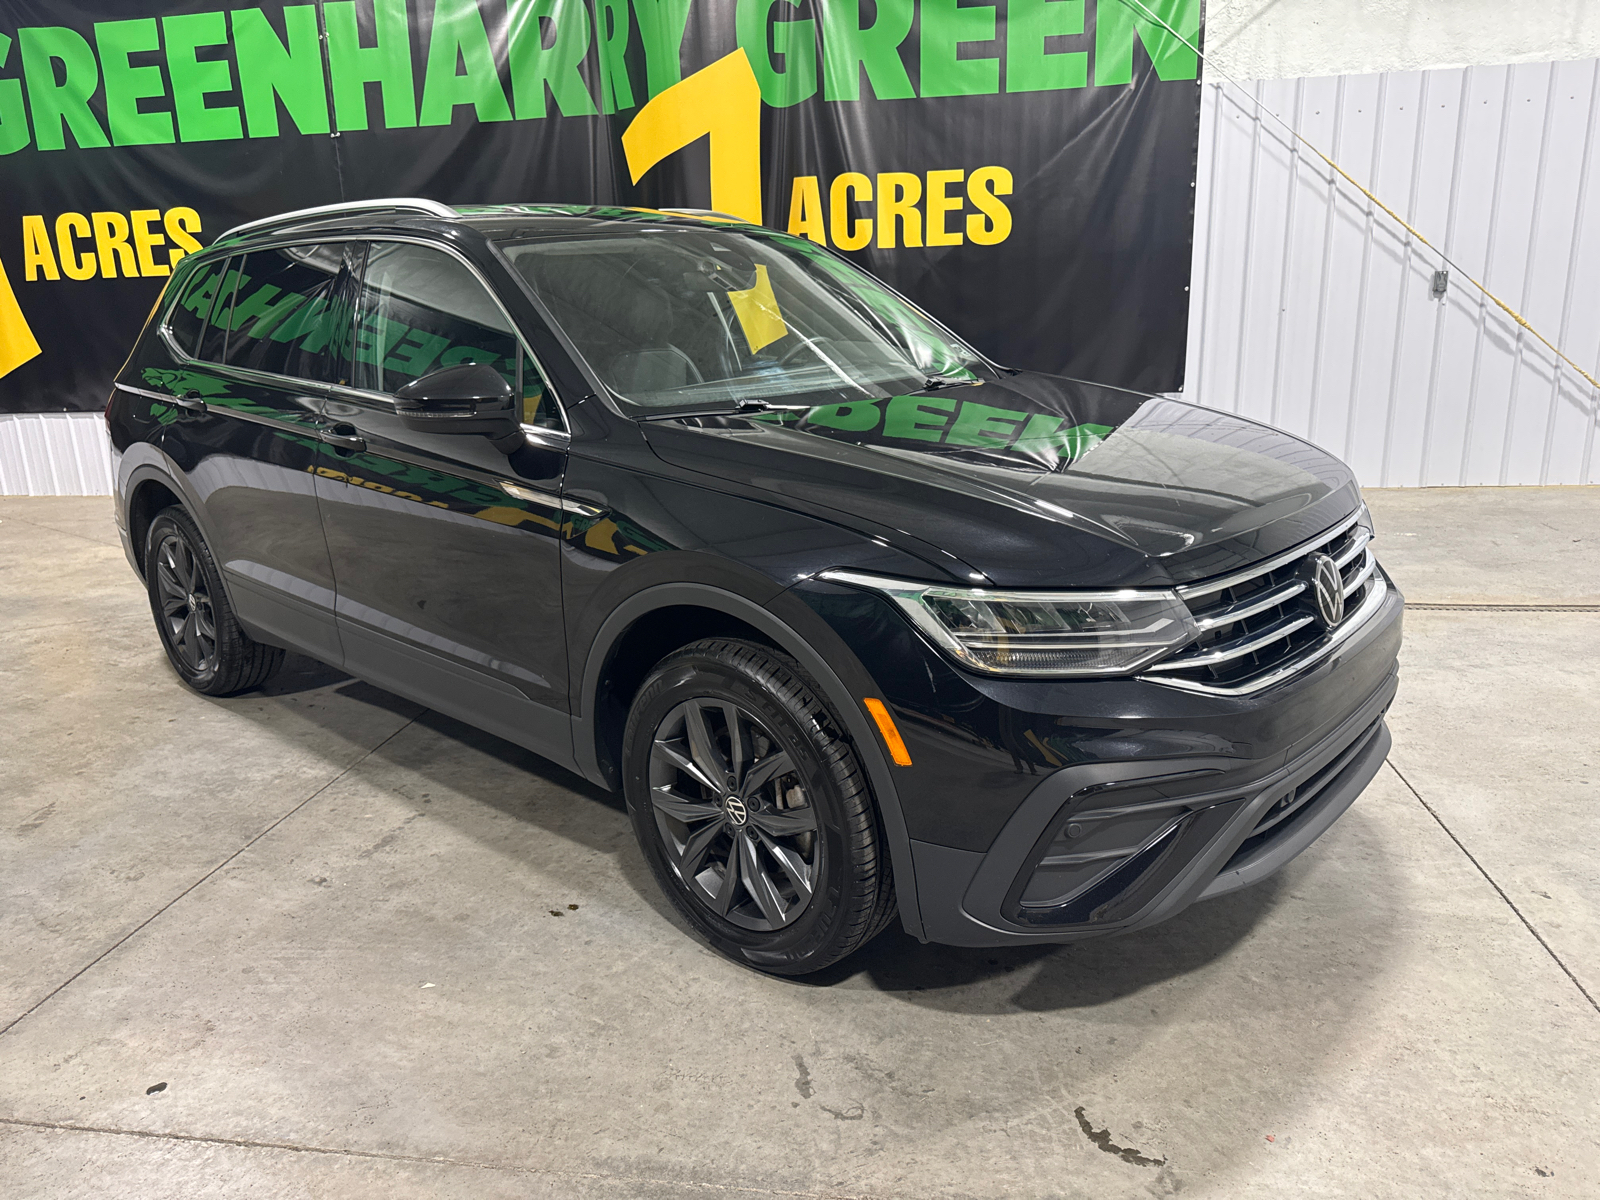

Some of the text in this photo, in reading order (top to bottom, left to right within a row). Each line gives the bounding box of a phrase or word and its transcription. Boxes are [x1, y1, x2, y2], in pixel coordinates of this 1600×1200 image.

[736, 0, 1200, 108] GREEN
[22, 206, 203, 282] ACRES
[788, 166, 1013, 251] ACRES
